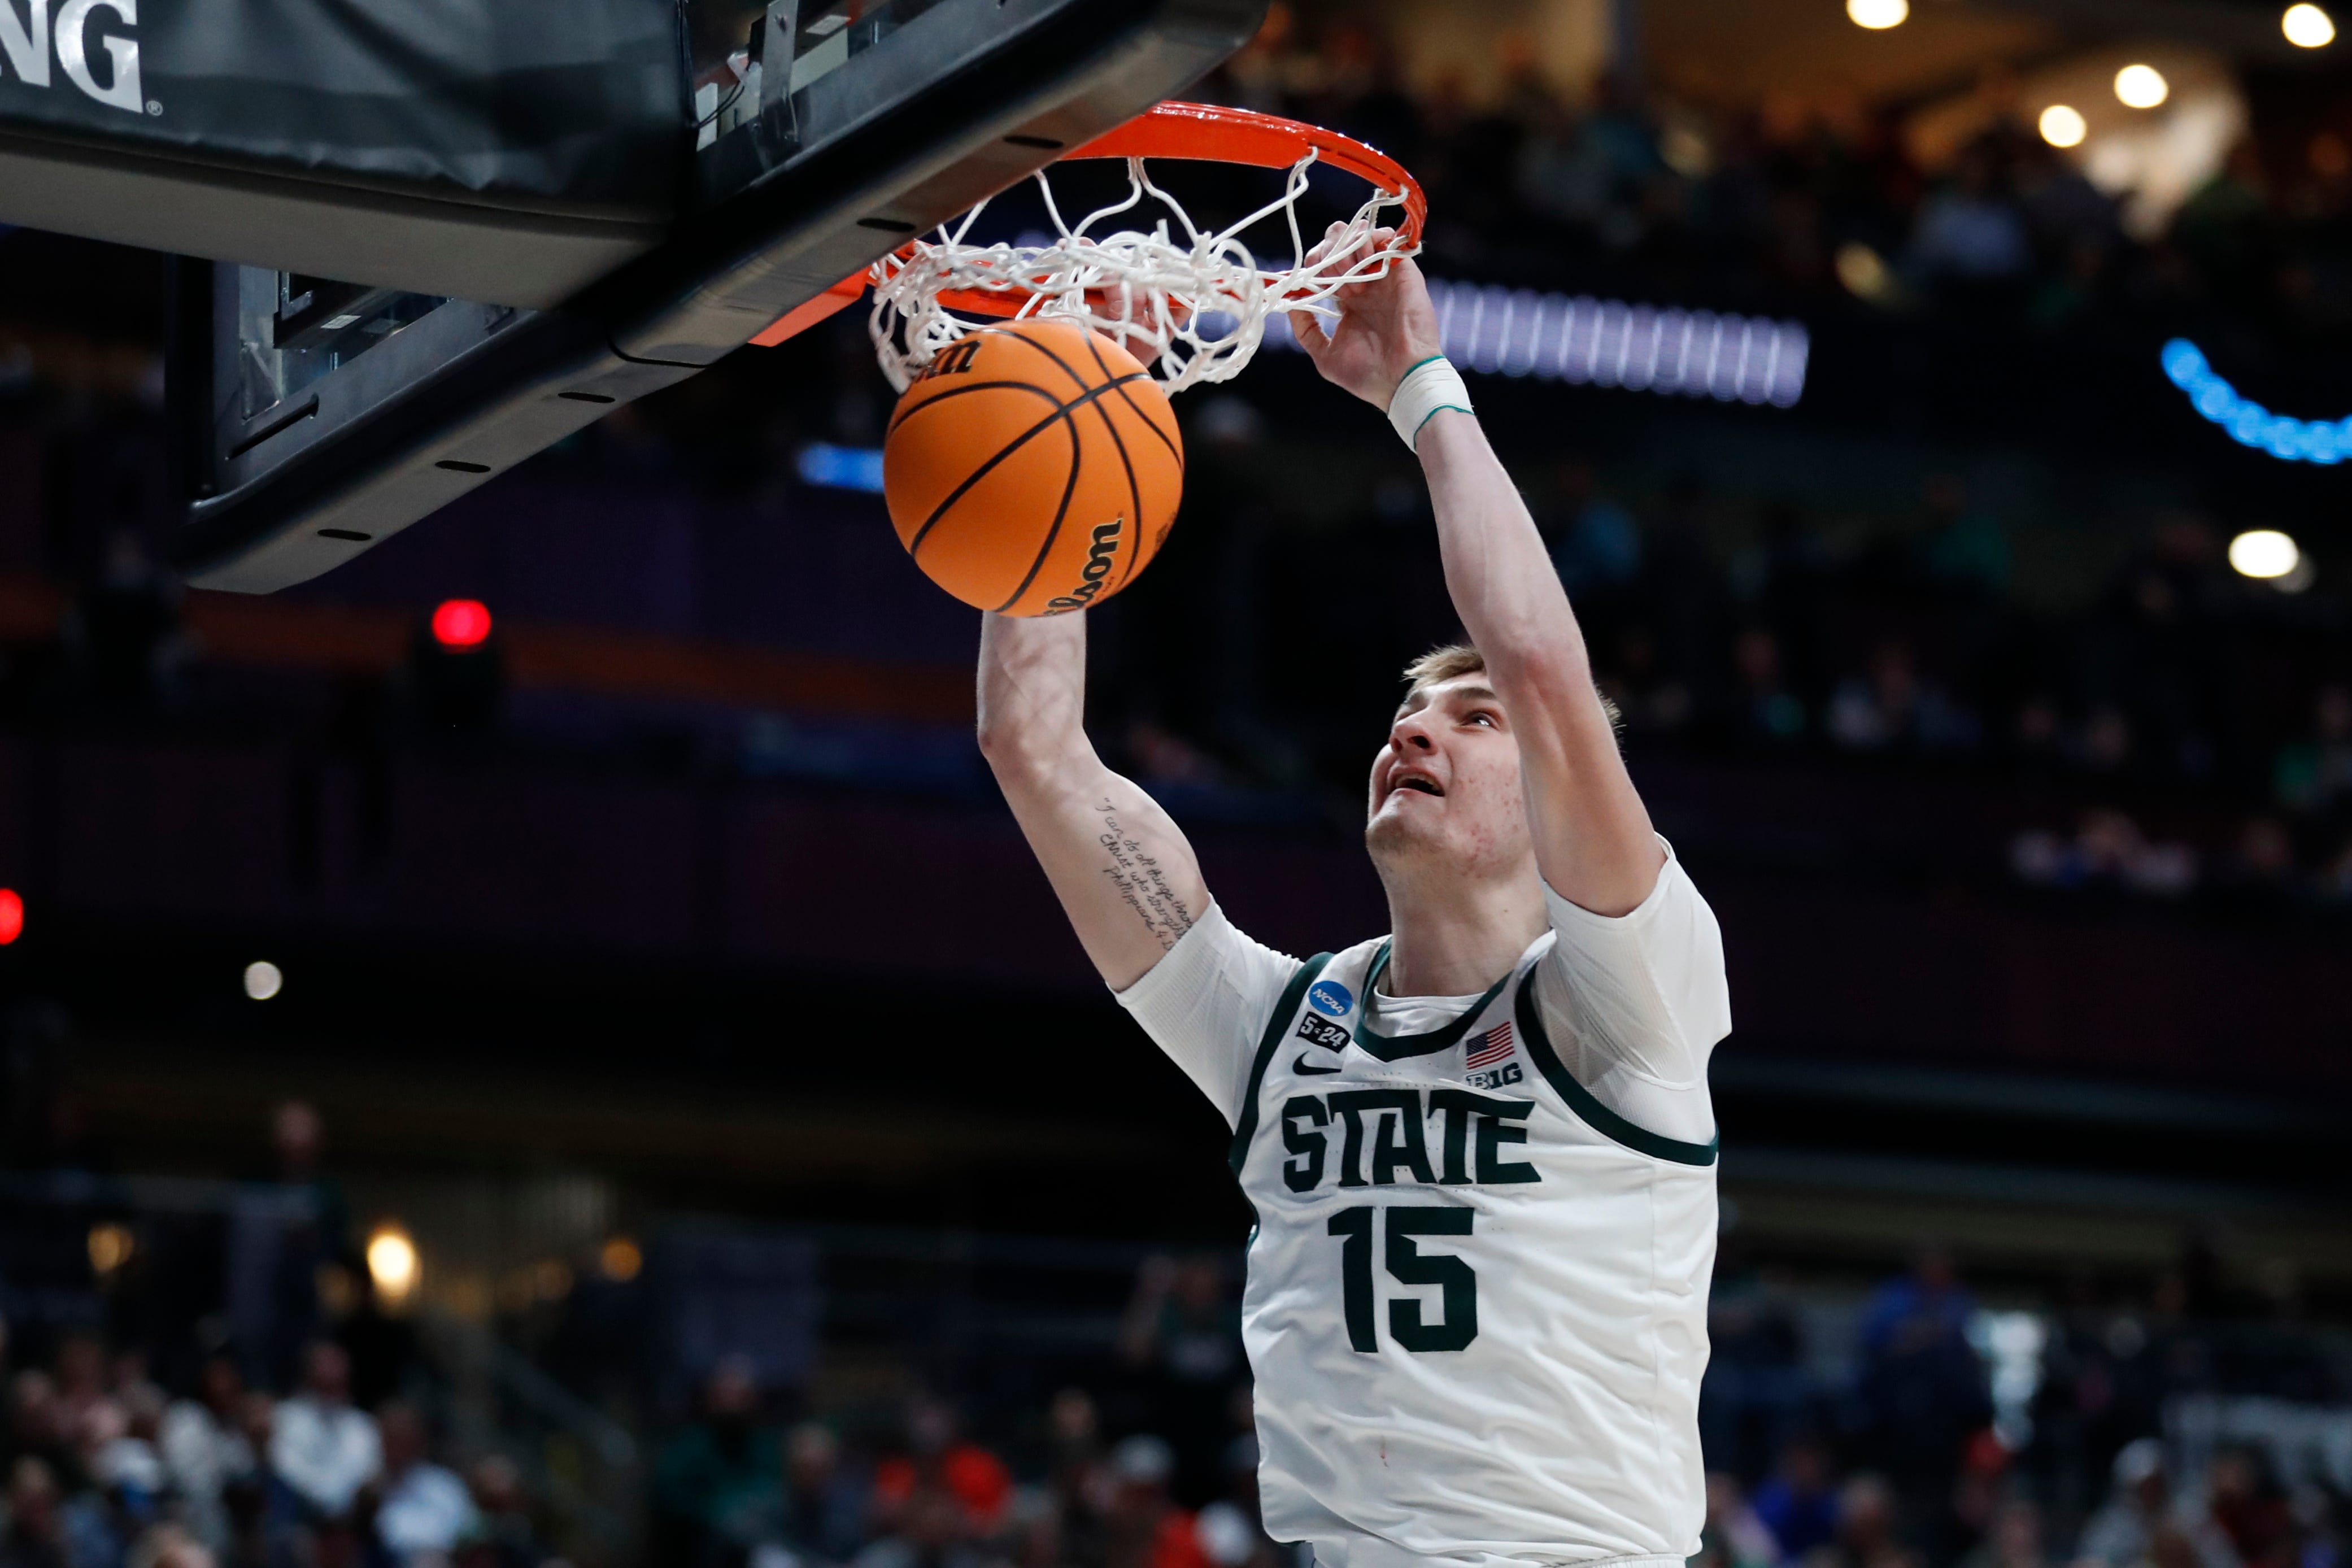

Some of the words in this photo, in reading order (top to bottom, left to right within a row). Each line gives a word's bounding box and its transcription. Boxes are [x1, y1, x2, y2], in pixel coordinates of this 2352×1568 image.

[1105, 816, 1124, 840] can
[1123, 840, 1140, 852] do
[1135, 854, 1157, 866] all
[1147, 869, 1174, 901] things
[1130, 871, 1151, 892] who
[1312, 988, 1345, 1014] NCAA
[1282, 1088, 1542, 1194] STATE
[1327, 1205, 1478, 1353] 15
